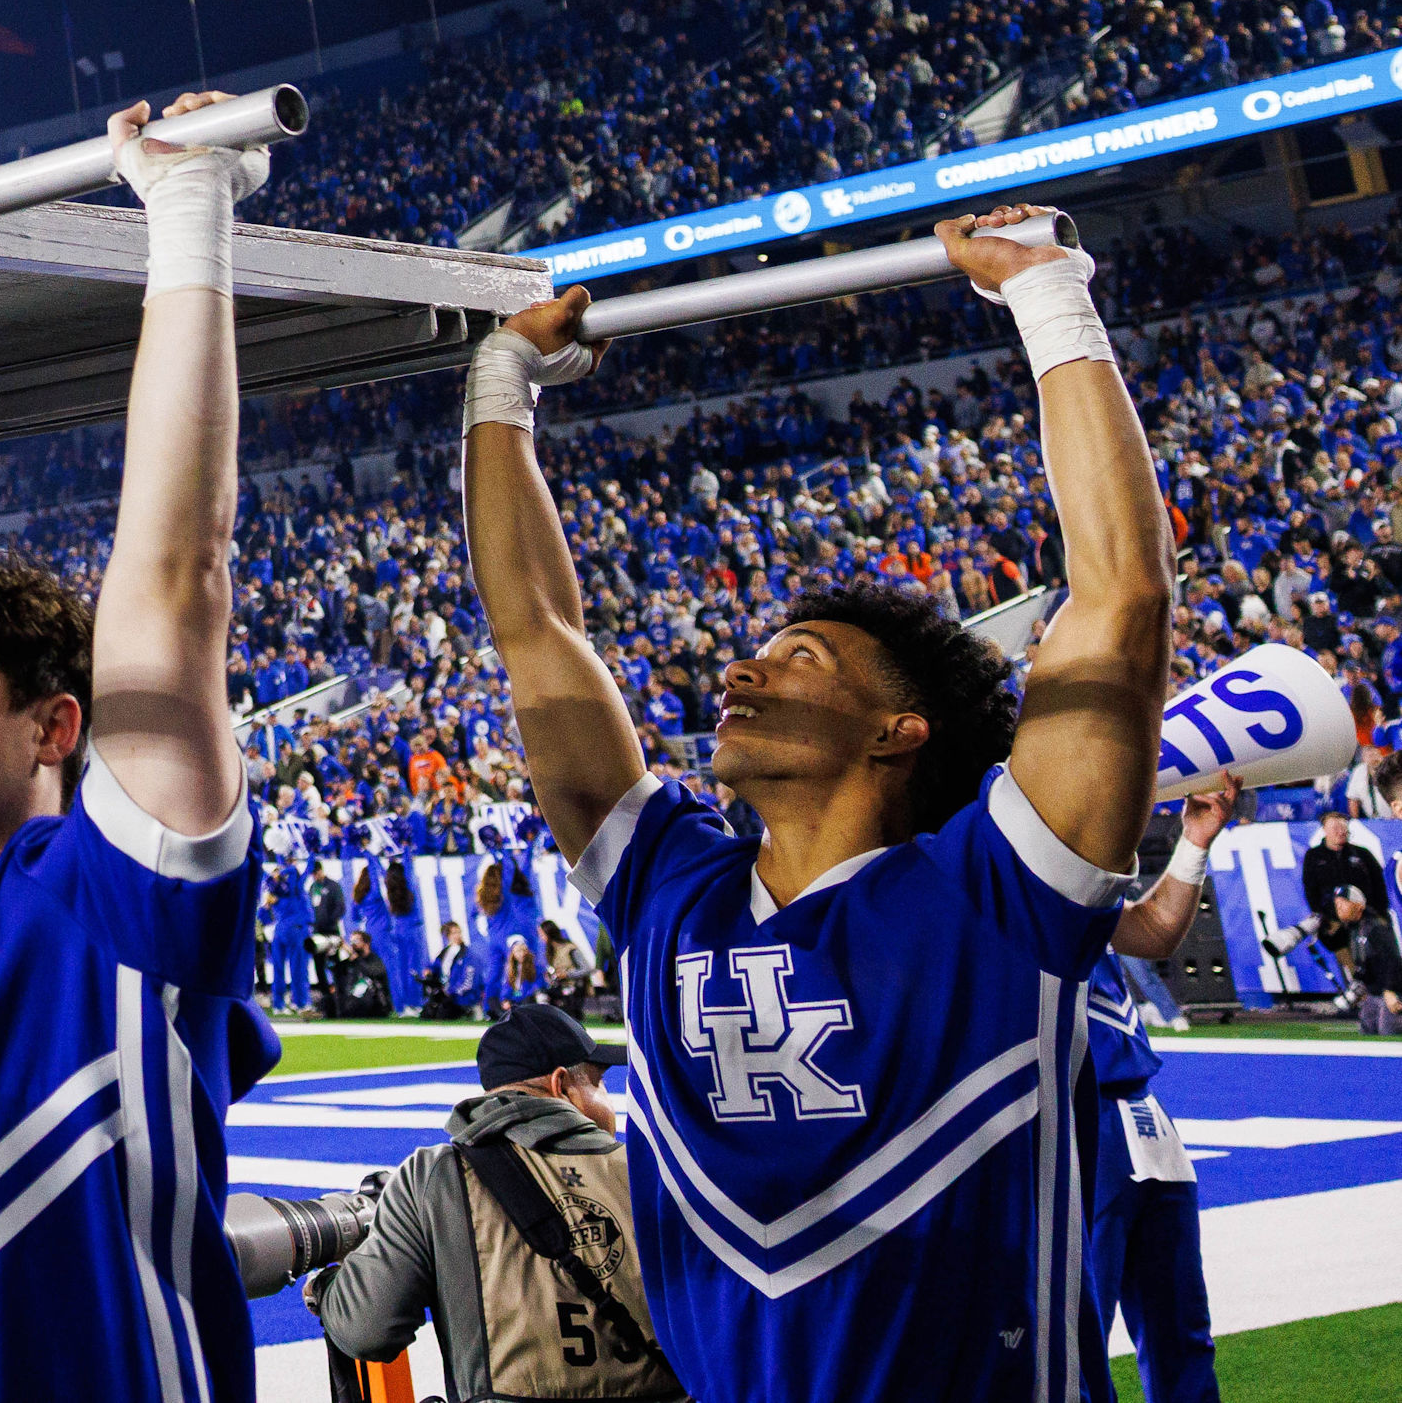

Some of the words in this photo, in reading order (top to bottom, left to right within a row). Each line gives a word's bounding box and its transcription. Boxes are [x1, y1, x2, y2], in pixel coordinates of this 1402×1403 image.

[1282, 81, 1335, 108] Central
[1334, 74, 1374, 96] Bank
[935, 135, 1095, 190] CORNERSTONE
[1095, 106, 1219, 154] PARTNERS
[555, 236, 647, 275] PARTNERS
[675, 943, 868, 1123] UK
